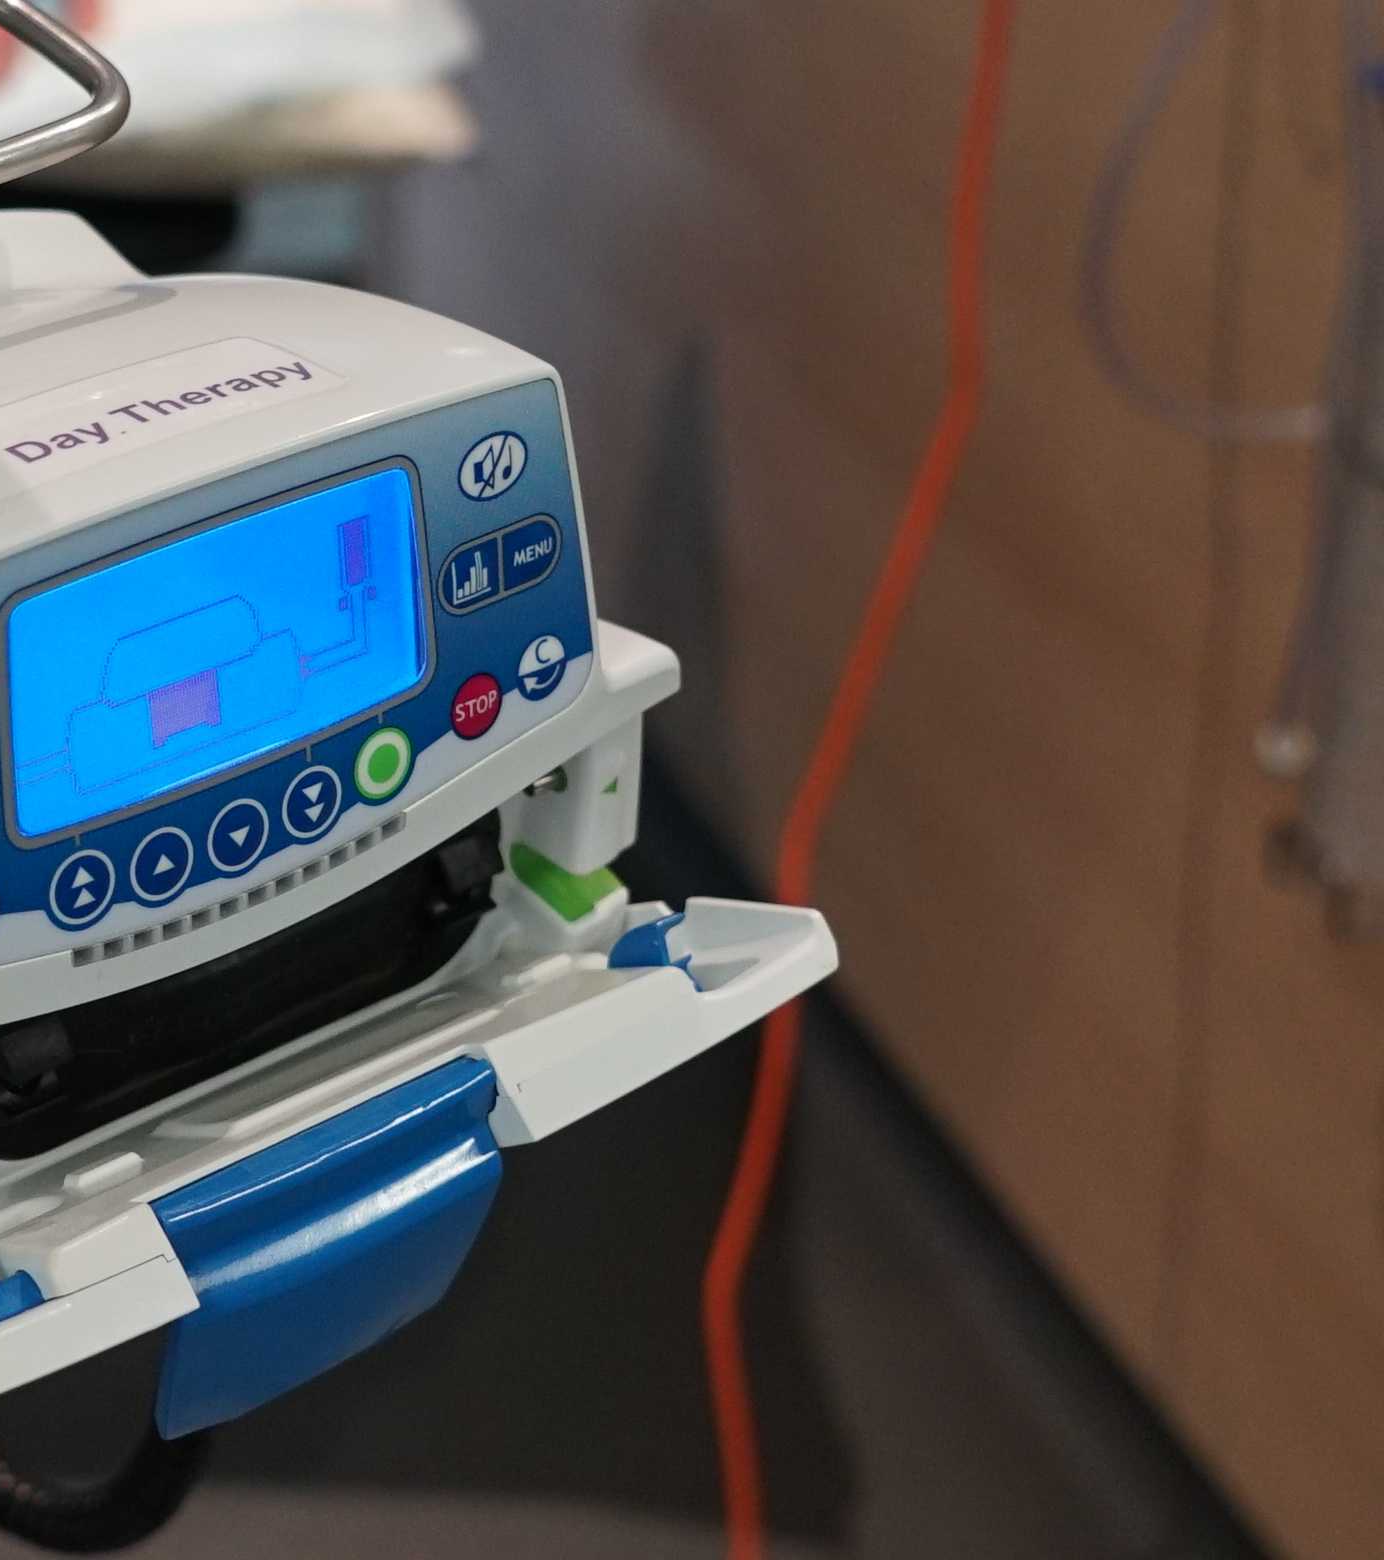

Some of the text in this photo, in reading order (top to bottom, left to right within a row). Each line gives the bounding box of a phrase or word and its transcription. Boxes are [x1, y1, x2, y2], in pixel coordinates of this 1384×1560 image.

[5, 361, 314, 464] Day Therapy
[513, 537, 553, 568] MENU
[534, 638, 550, 665] C
[454, 689, 498, 723] STOP
